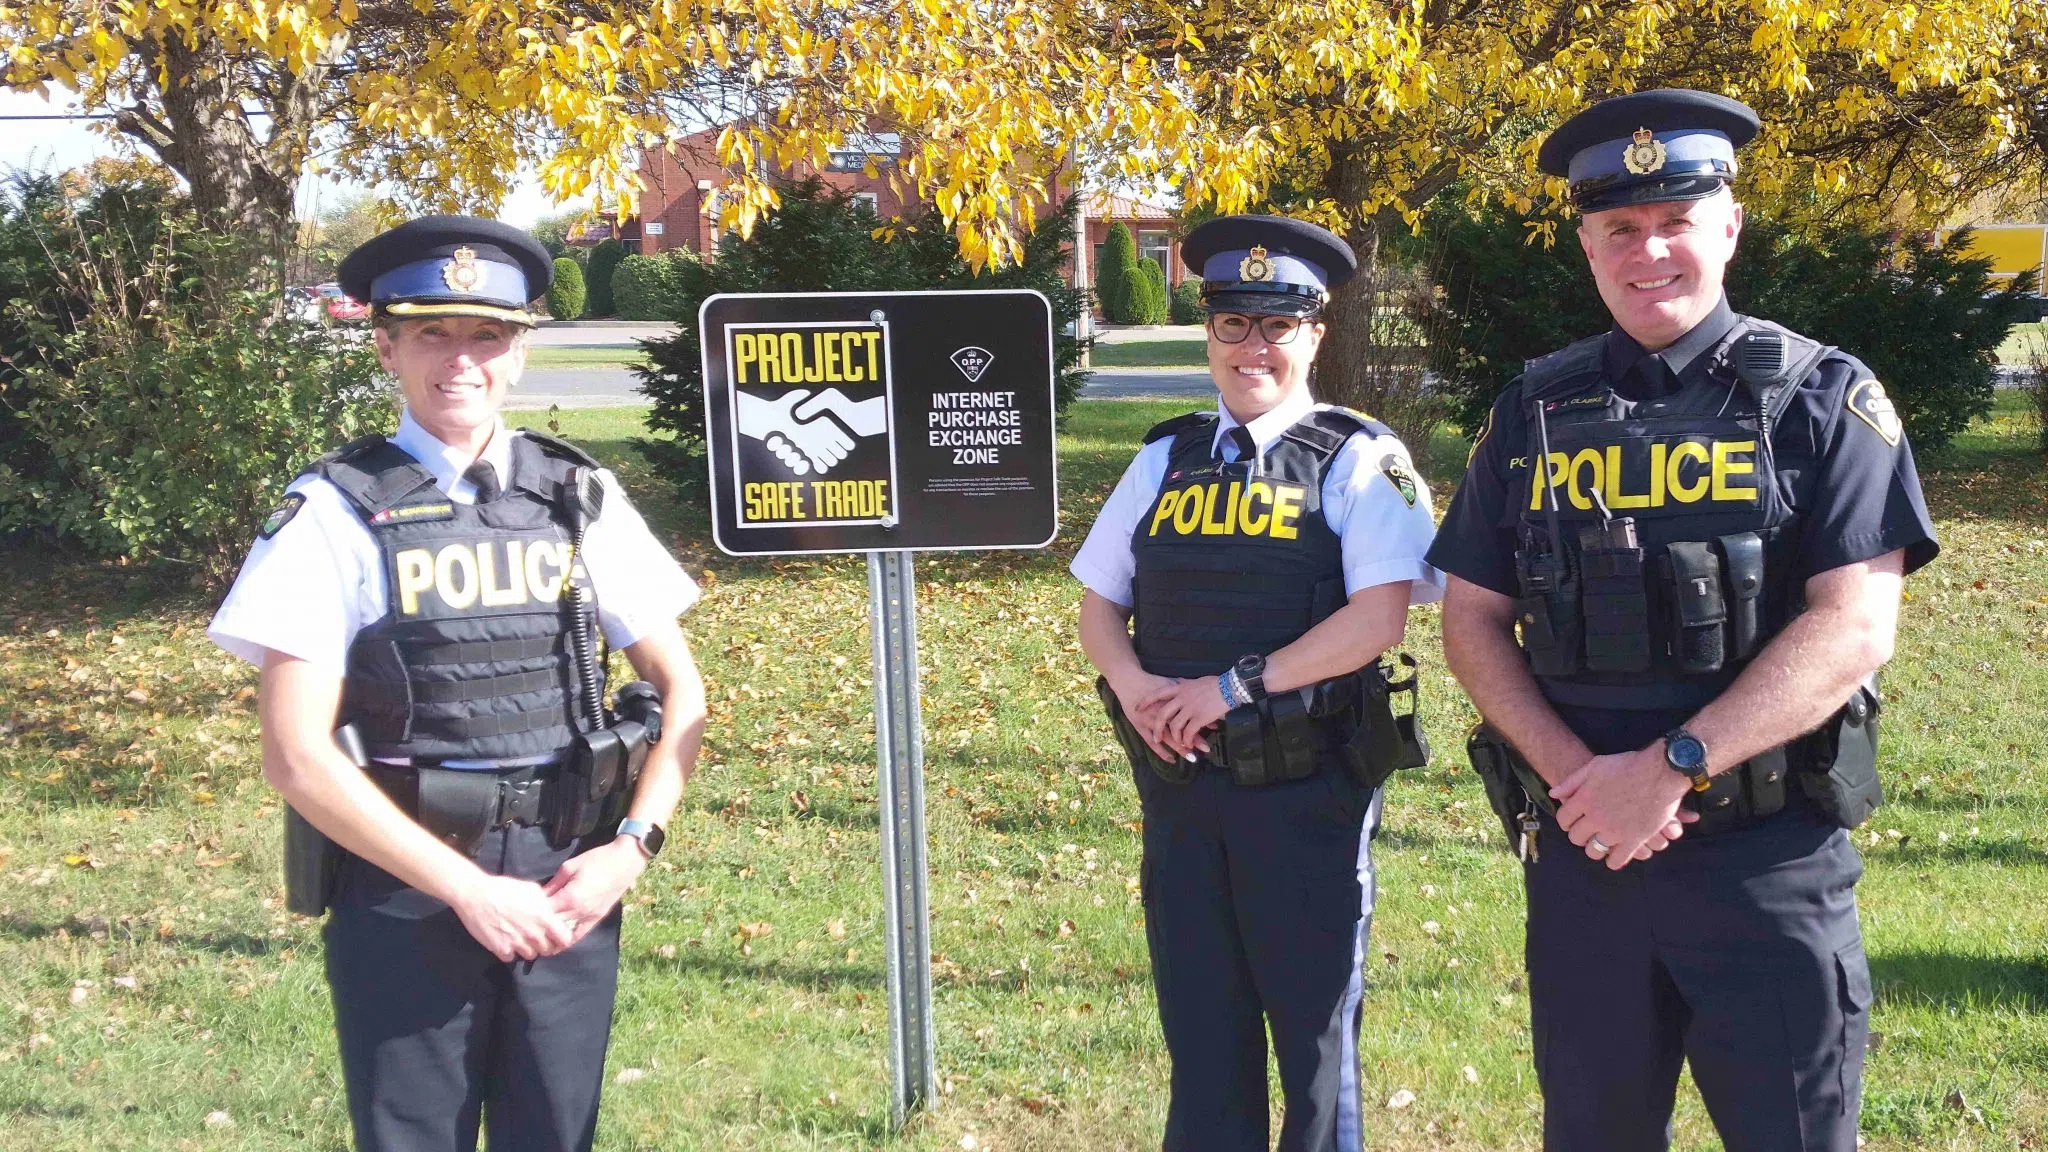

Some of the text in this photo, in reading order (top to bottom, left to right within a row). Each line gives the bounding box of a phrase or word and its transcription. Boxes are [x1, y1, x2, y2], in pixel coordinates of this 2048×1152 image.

[735, 332, 880, 383] PROJECT
[932, 391, 1016, 409] INTERNET
[928, 410, 1021, 427] PURCHASE
[928, 429, 1022, 446] EXCHANGE
[952, 448, 1000, 464] ZONE
[1529, 440, 1758, 511] POLICE
[744, 483, 805, 520] SAFE
[811, 480, 888, 518] TRADE
[1149, 482, 1304, 540] POLICE
